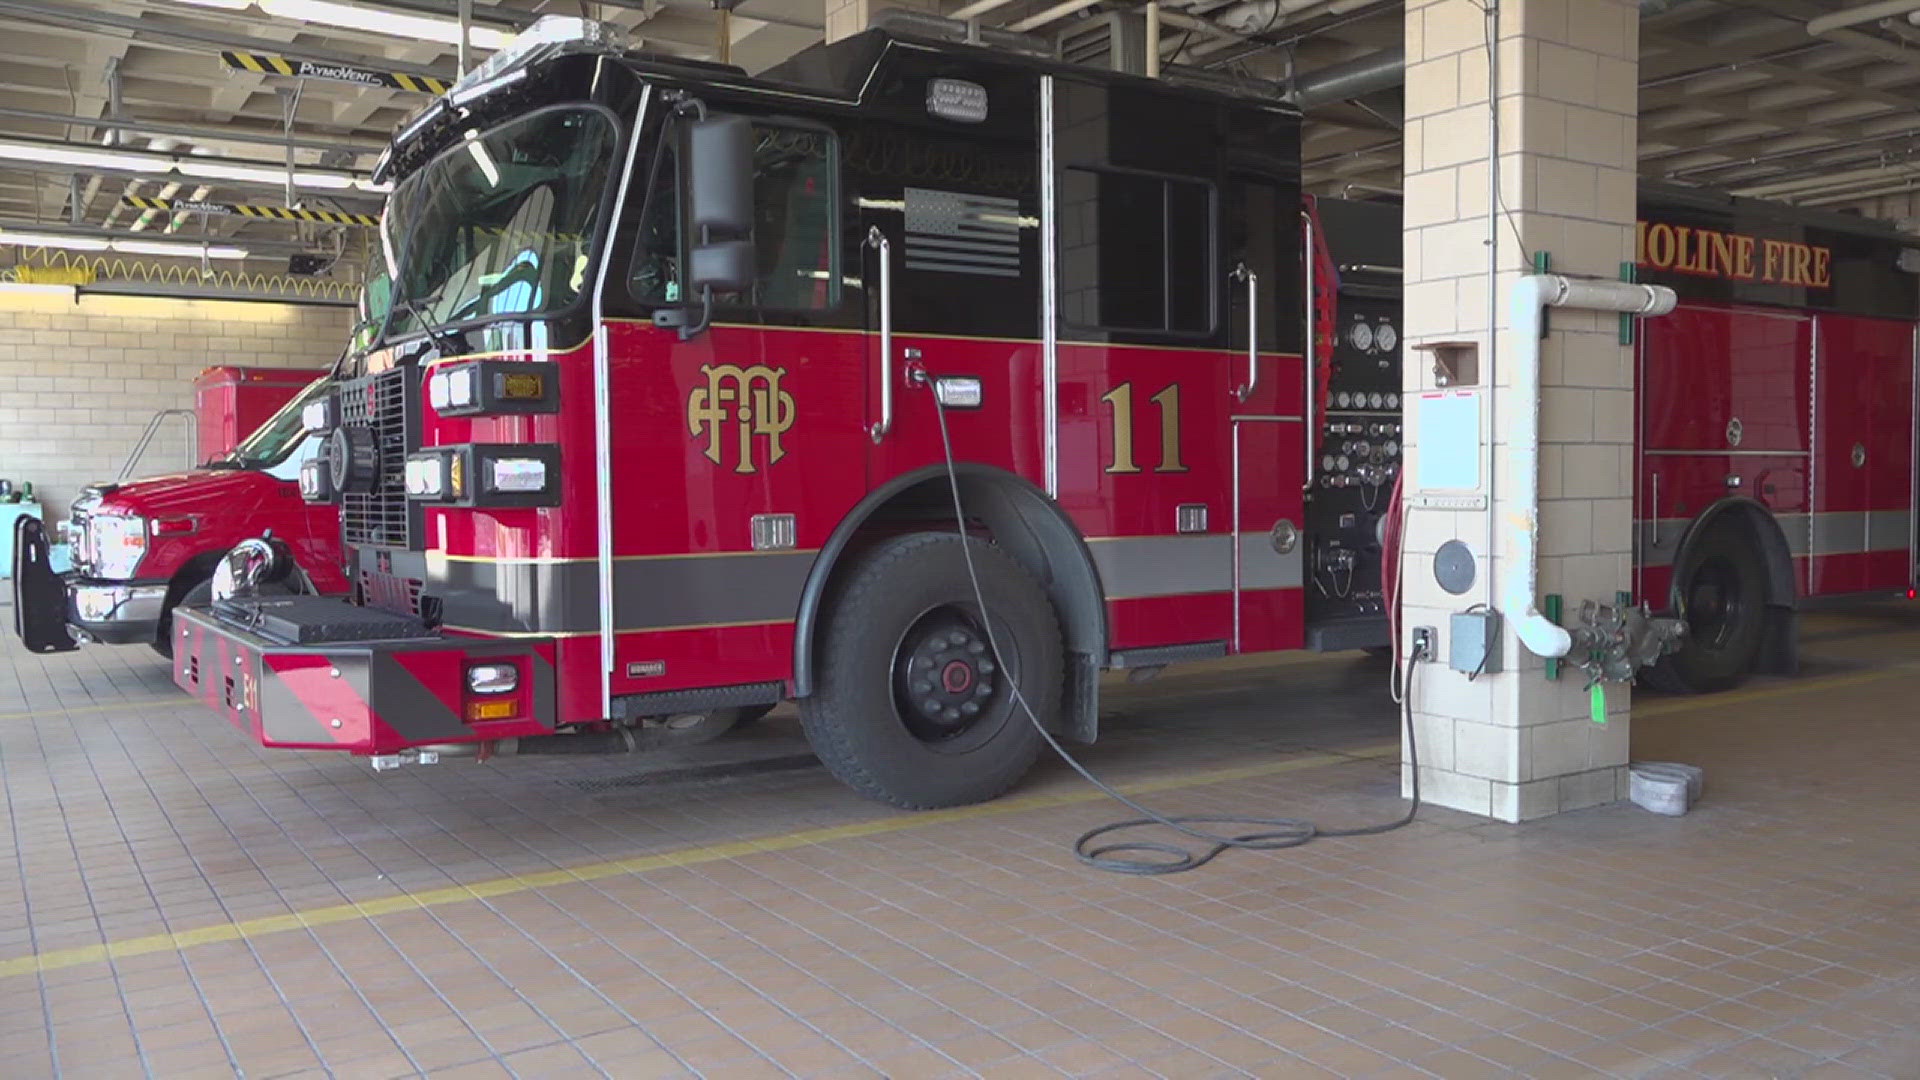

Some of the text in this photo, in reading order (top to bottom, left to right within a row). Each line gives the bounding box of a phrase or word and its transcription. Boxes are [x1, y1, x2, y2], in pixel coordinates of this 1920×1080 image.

[300, 61, 374, 82] PLYMOVENT
[1763, 238, 1831, 288] FIRE
[1101, 380, 1190, 473] 11
